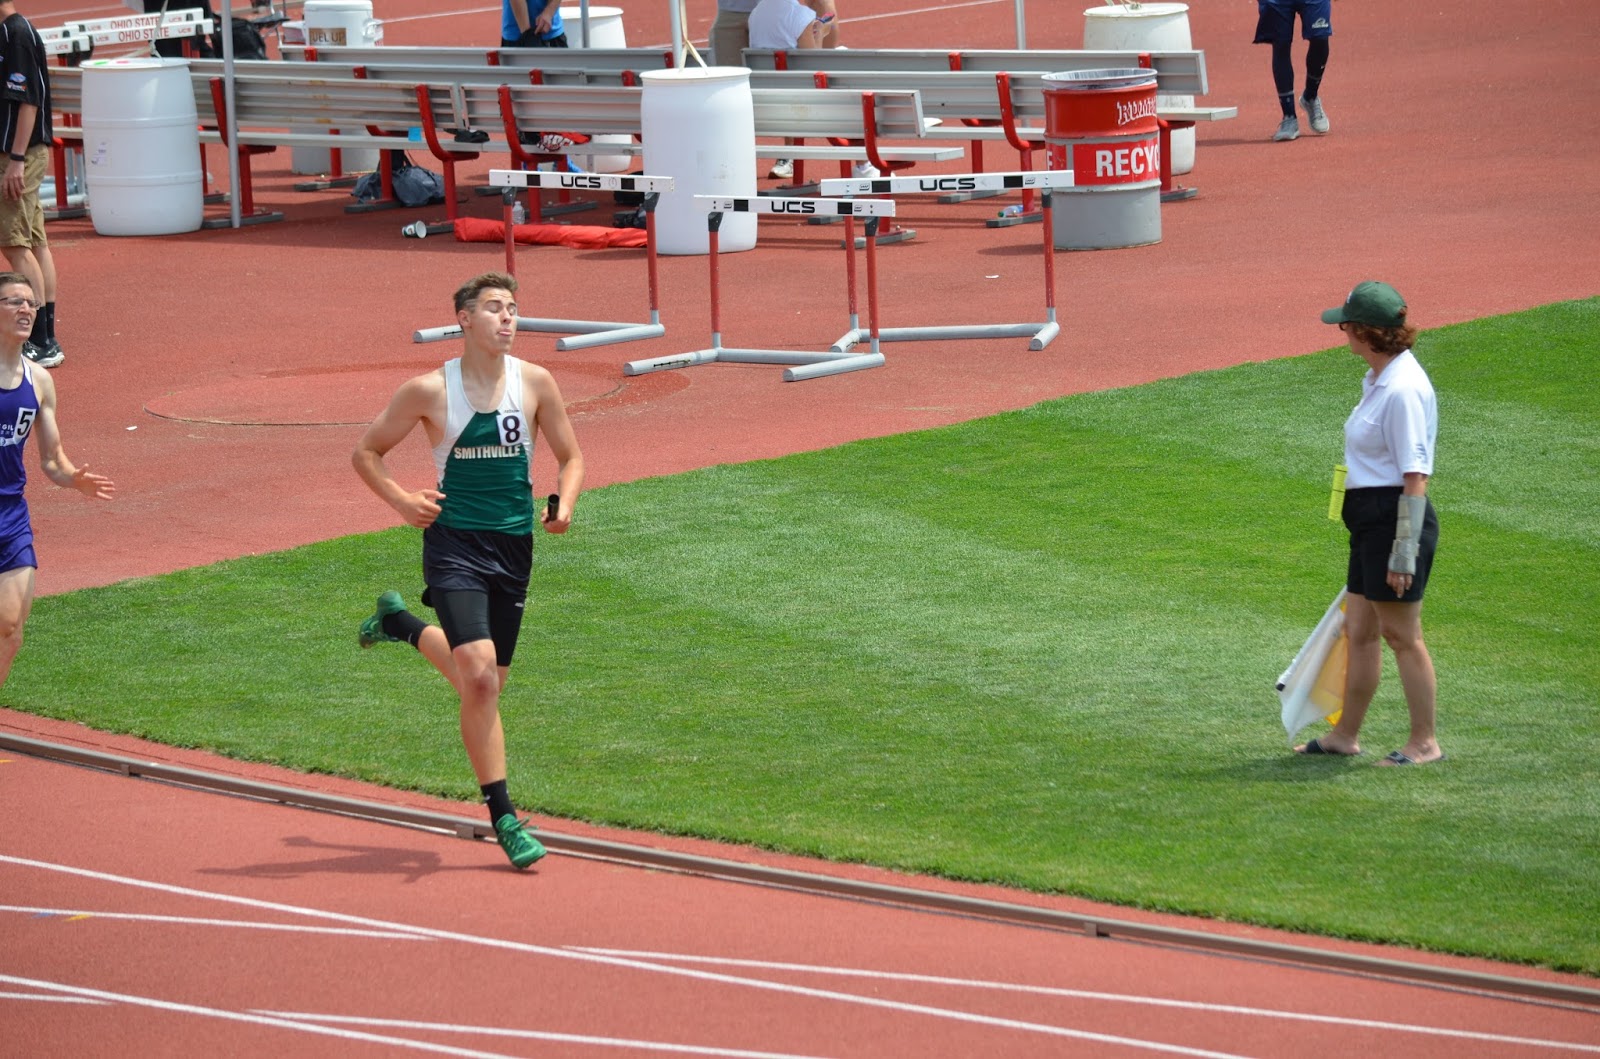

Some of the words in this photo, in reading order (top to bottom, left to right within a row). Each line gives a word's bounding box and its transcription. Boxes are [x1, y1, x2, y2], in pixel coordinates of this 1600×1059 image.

[110, 19, 133, 30] OHIO
[118, 30, 141, 42] OHIO
[143, 27, 170, 39] STTE
[561, 175, 601, 189] UCS
[919, 177, 976, 191] UCS
[771, 200, 816, 213] UCS
[17, 411, 33, 436] 5
[502, 415, 520, 443] 8
[454, 445, 520, 459] SMITHVILLE
